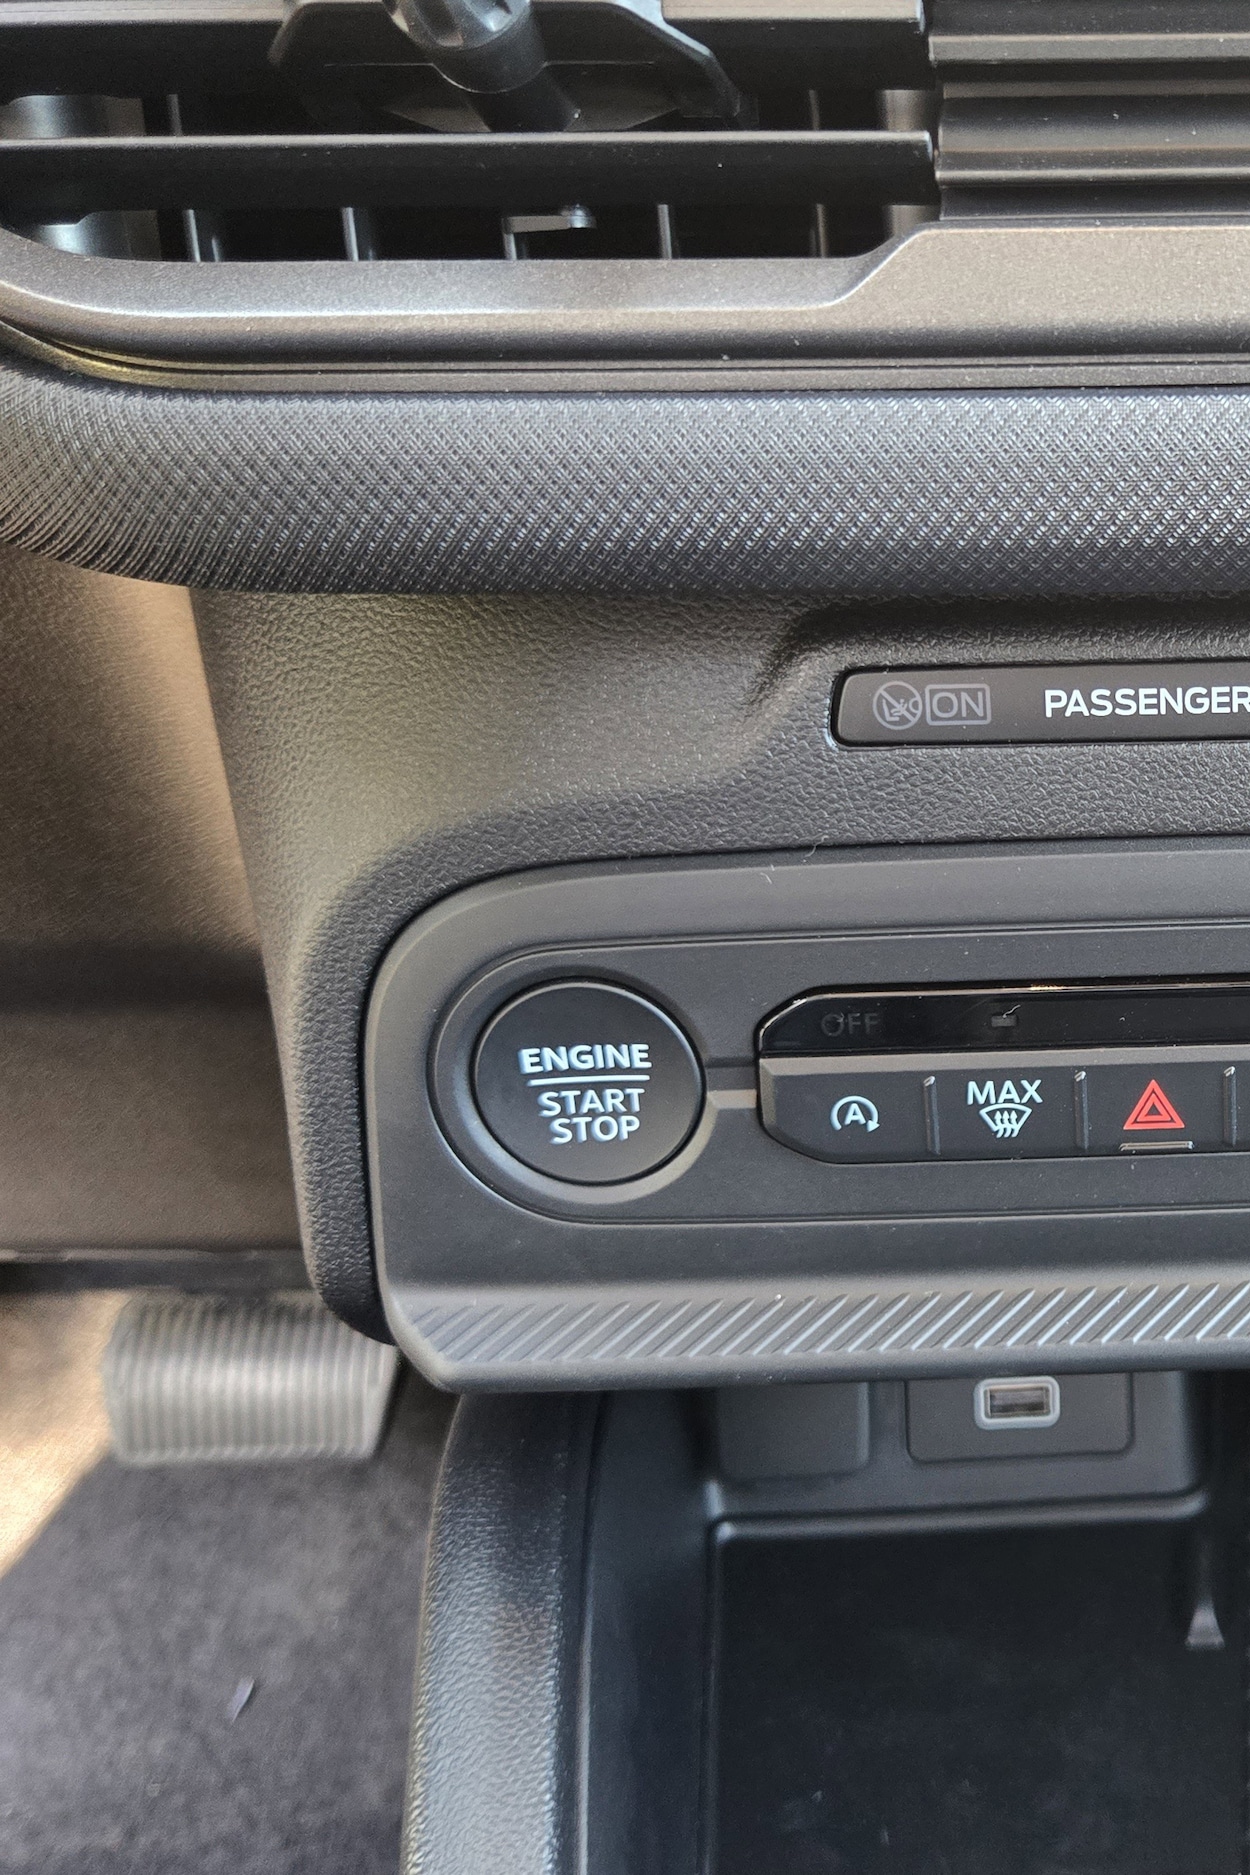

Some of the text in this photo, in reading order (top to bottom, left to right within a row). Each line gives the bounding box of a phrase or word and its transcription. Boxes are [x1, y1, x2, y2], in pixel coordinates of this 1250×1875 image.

[932, 690, 984, 718] ON
[820, 1011, 880, 1037] OFF
[518, 1043, 652, 1075] ENGINE
[537, 1087, 645, 1117] START
[966, 1079, 1044, 1105] MAX
[550, 1115, 641, 1145] STOP
